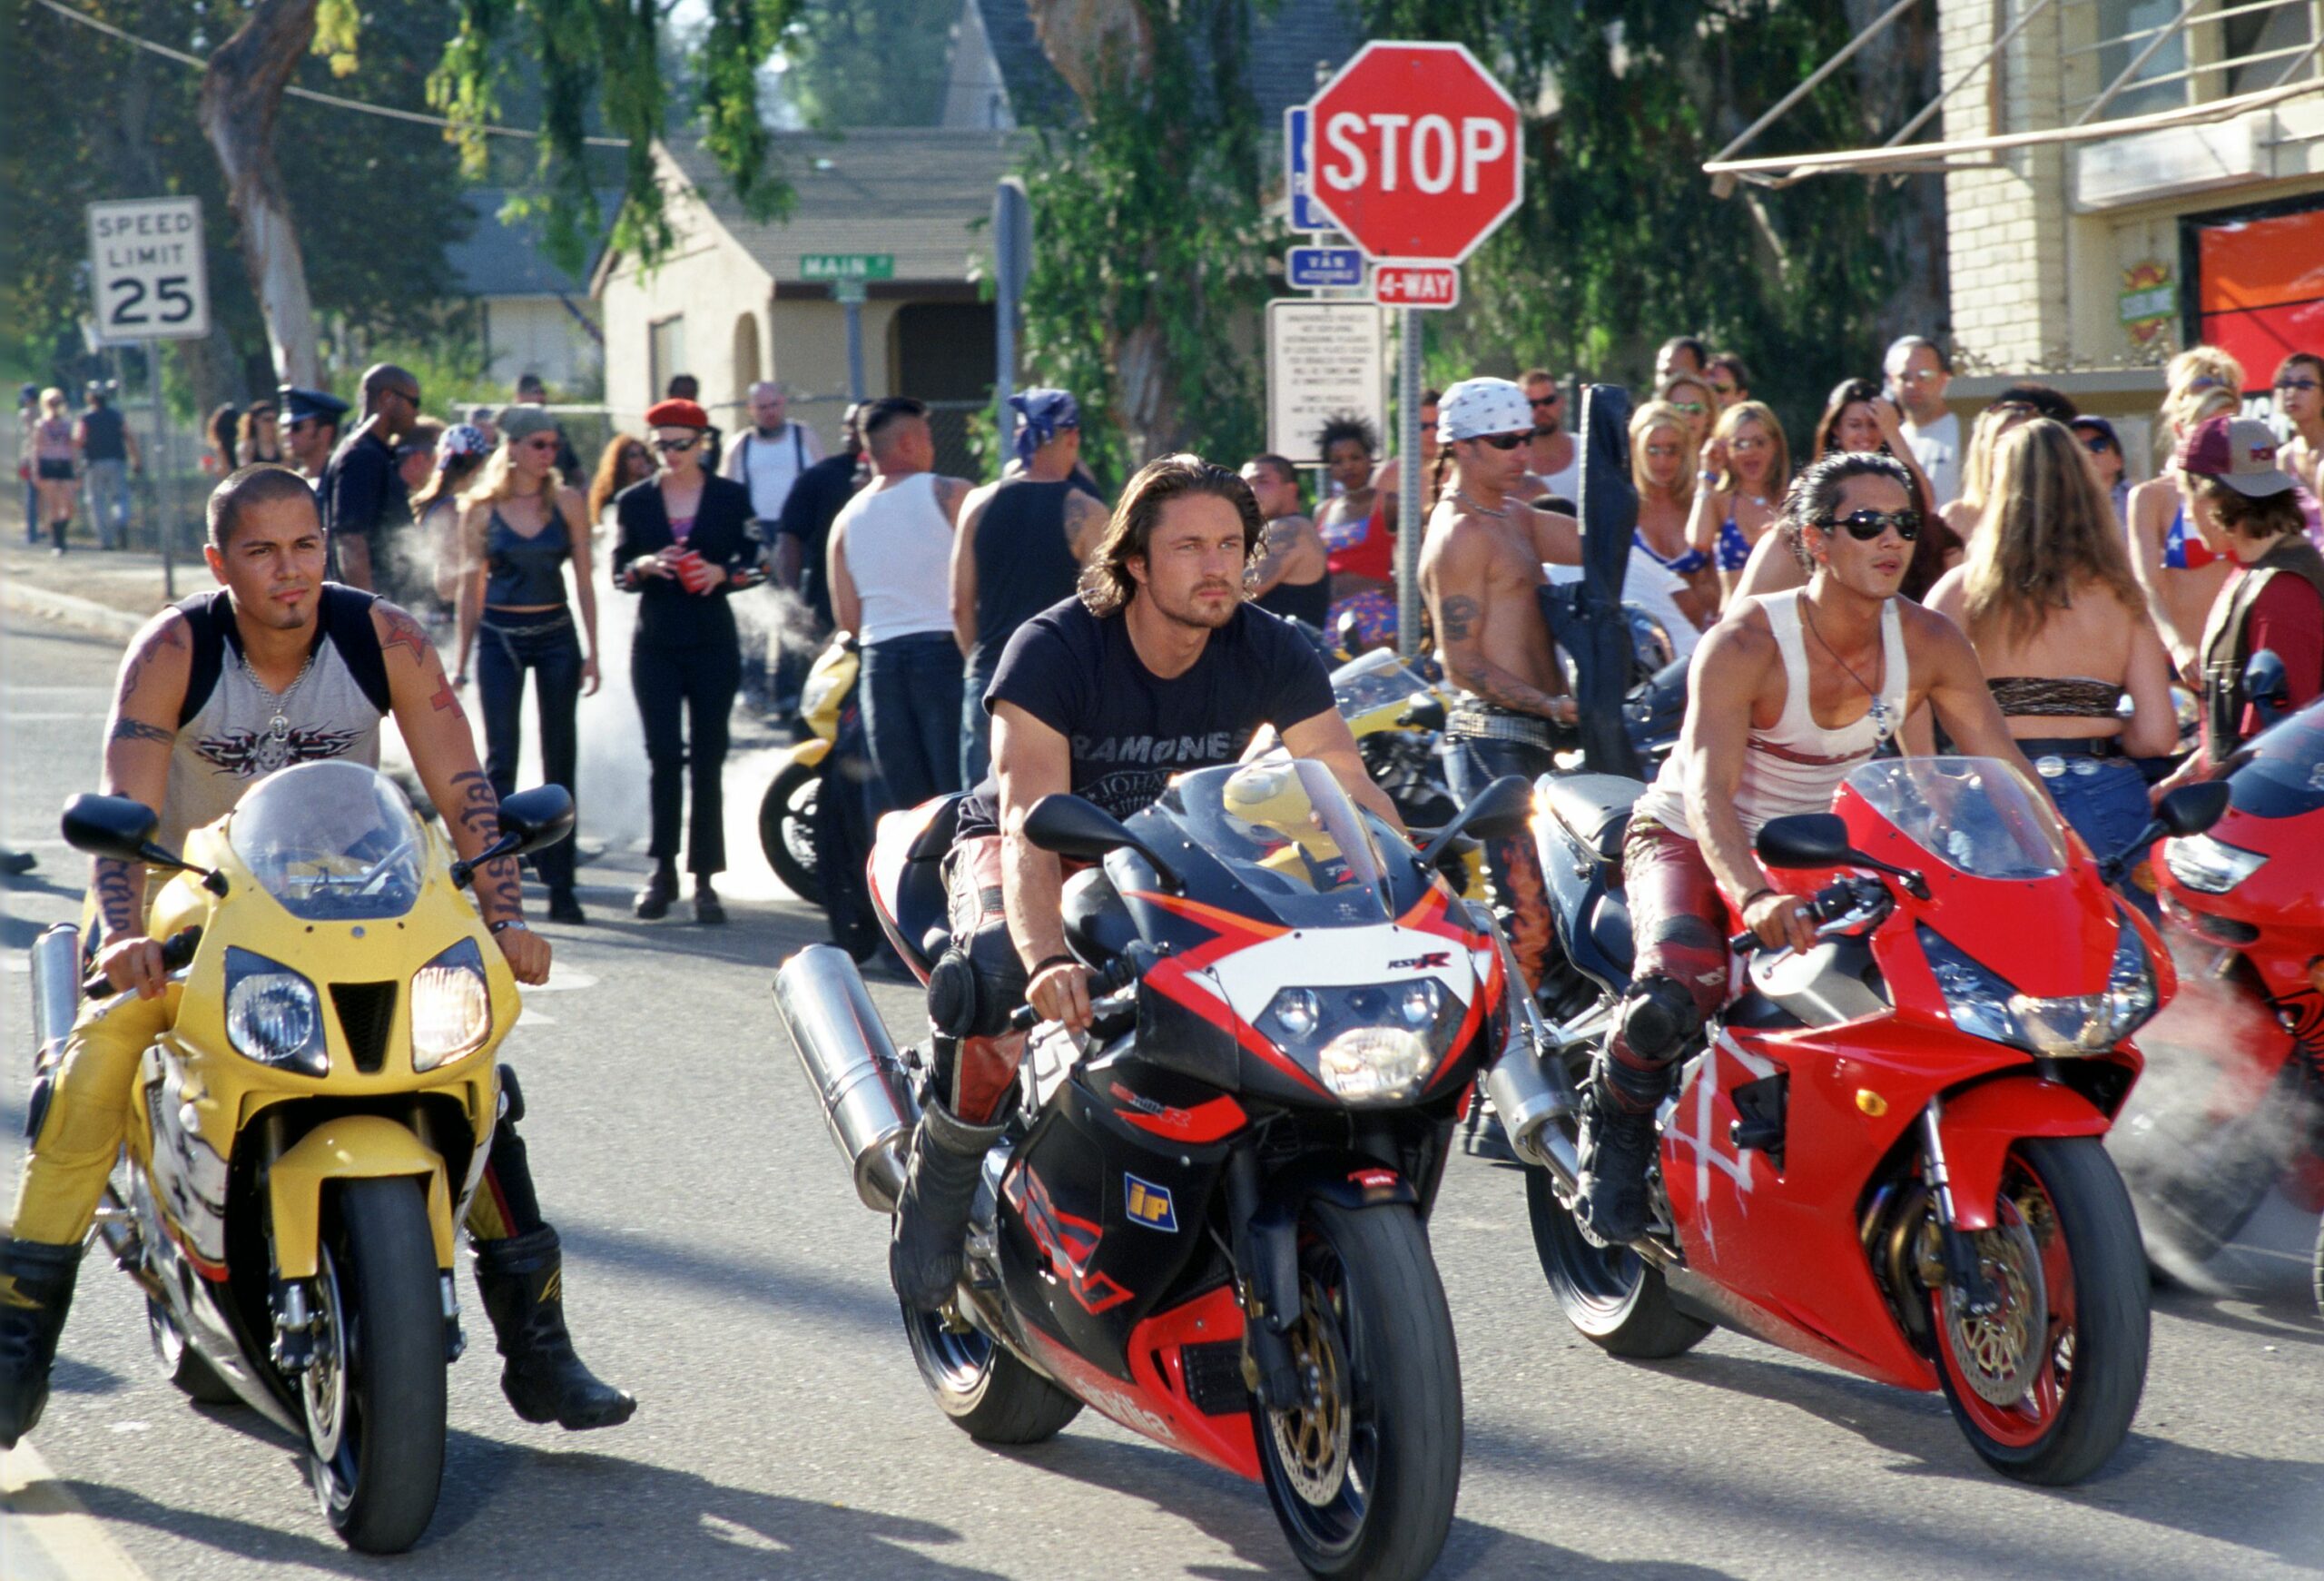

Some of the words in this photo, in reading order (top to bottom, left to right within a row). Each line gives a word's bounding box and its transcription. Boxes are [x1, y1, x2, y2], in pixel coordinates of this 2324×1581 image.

[1323, 112, 1507, 194] STOP
[97, 213, 192, 237] SPEED
[108, 244, 184, 268] LIMIT
[804, 257, 867, 274] MAIN
[1379, 273, 1452, 297] 4-WAY
[109, 276, 193, 324] 25
